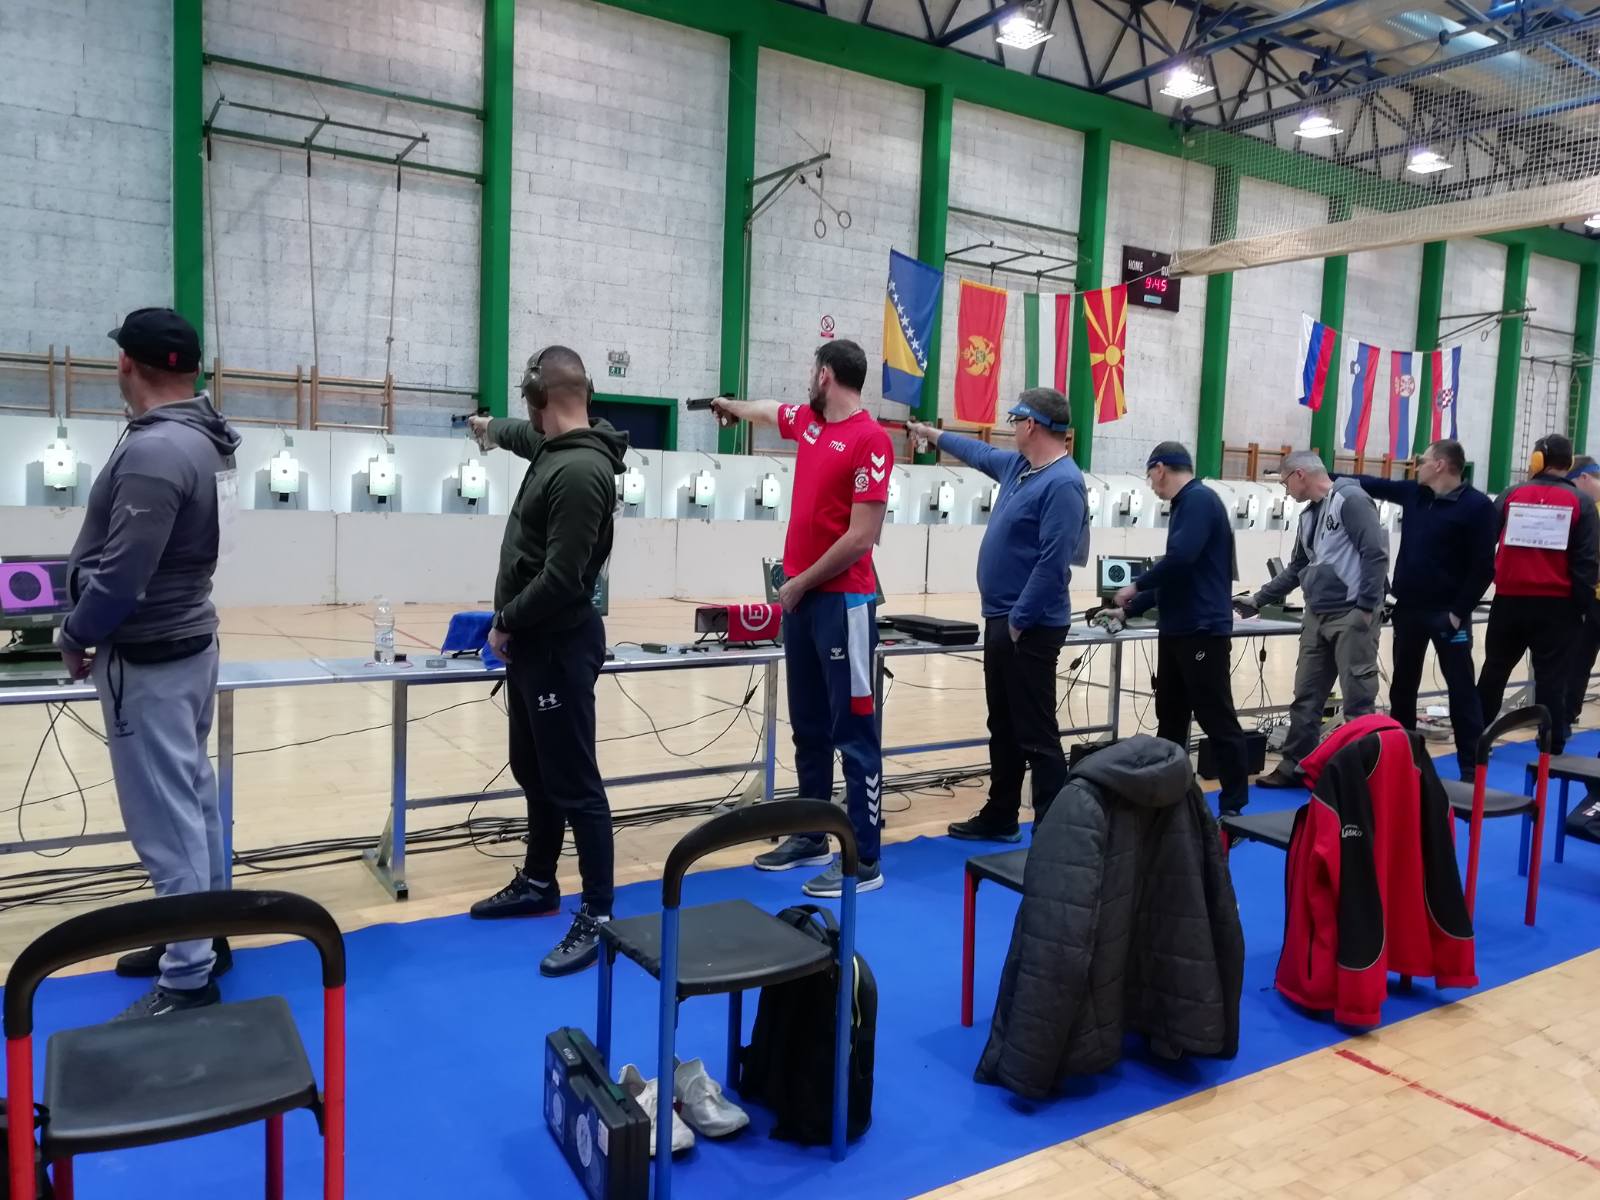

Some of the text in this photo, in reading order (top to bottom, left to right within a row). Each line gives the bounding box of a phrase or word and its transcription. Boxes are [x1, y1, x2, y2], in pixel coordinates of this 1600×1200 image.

[1127, 259, 1143, 272] HOME
[1160, 265, 1169, 277] GU
[828, 440, 846, 452] mts
